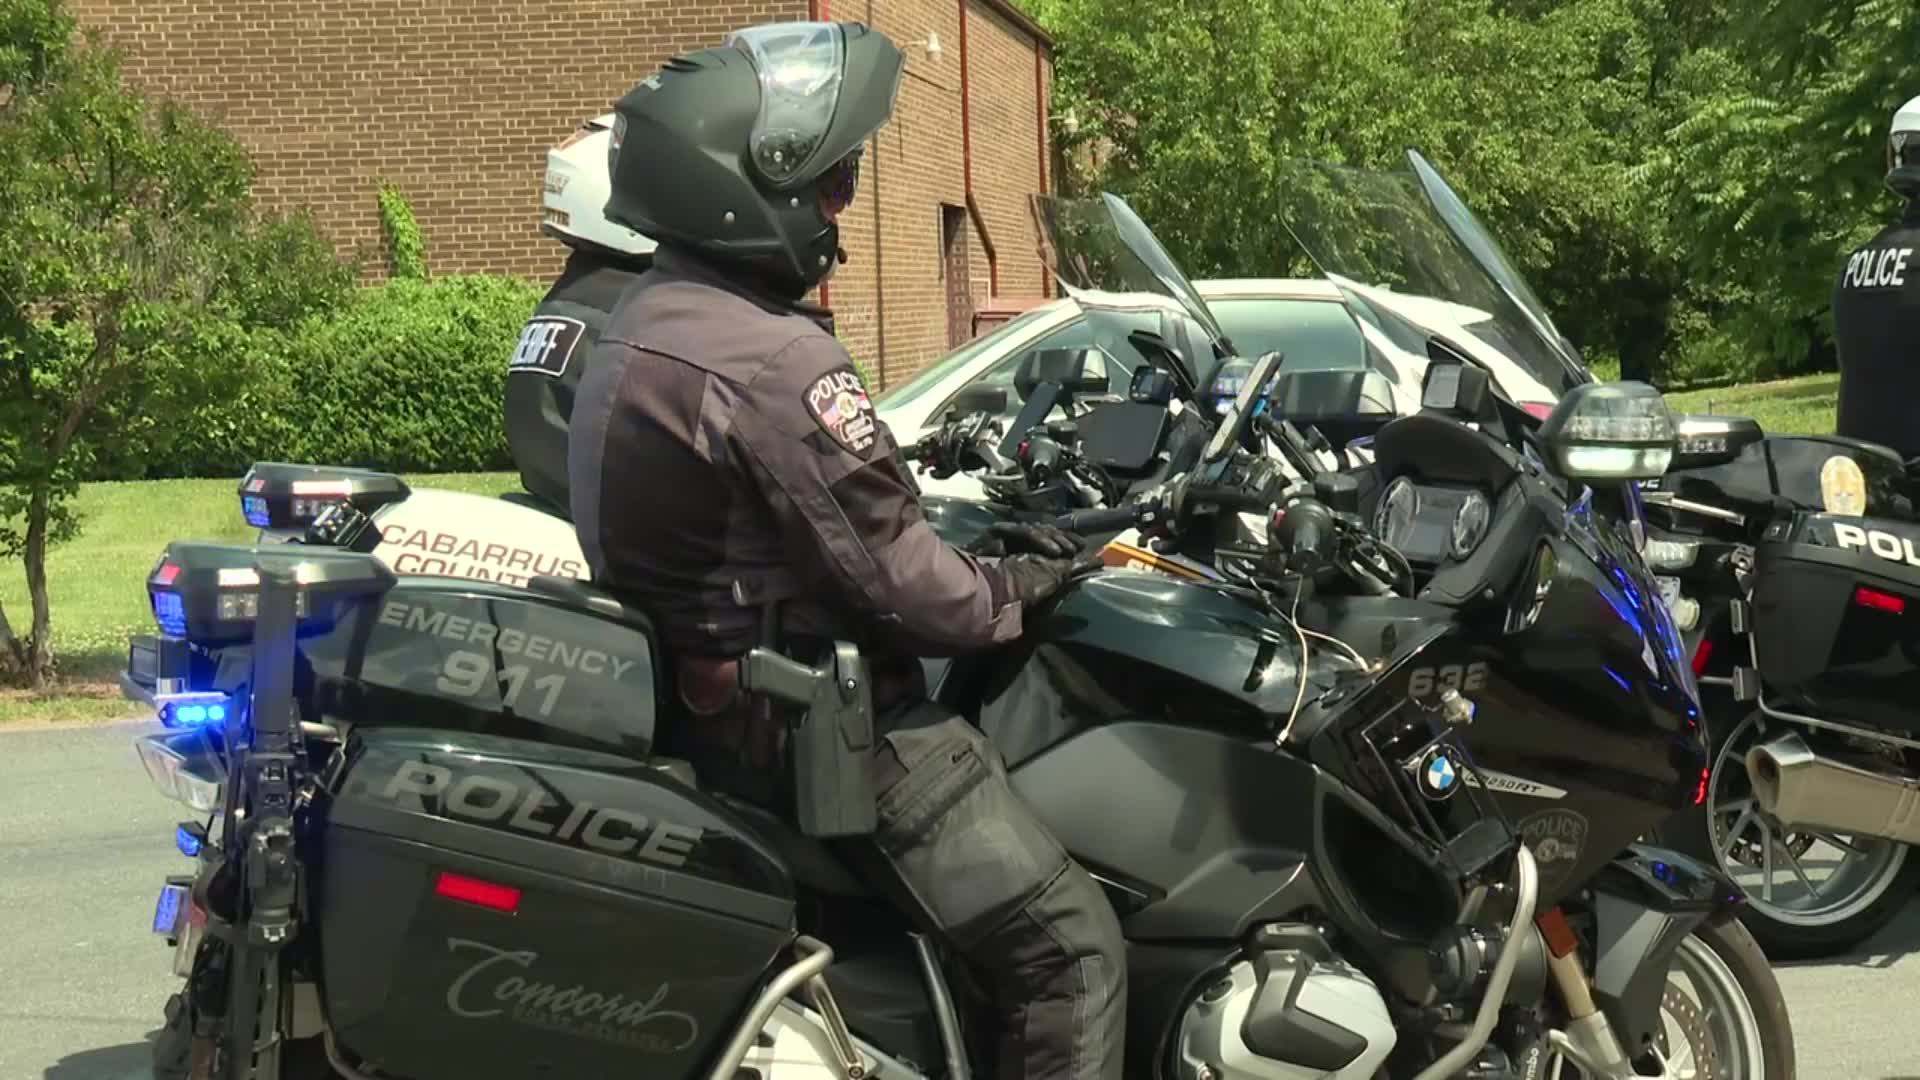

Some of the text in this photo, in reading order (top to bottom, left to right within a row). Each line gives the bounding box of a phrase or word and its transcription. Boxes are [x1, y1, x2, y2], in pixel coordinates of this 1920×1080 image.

[1843, 248, 1913, 288] POLICE
[381, 524, 582, 579] CABARRUS
[393, 553, 530, 585] COUNT
[1832, 521, 1920, 567] POL
[378, 601, 635, 681] EMERGENCY
[436, 650, 567, 716] 911
[1408, 662, 1489, 697] 632
[384, 759, 705, 867] POLICE
[447, 936, 698, 1051] Concord
